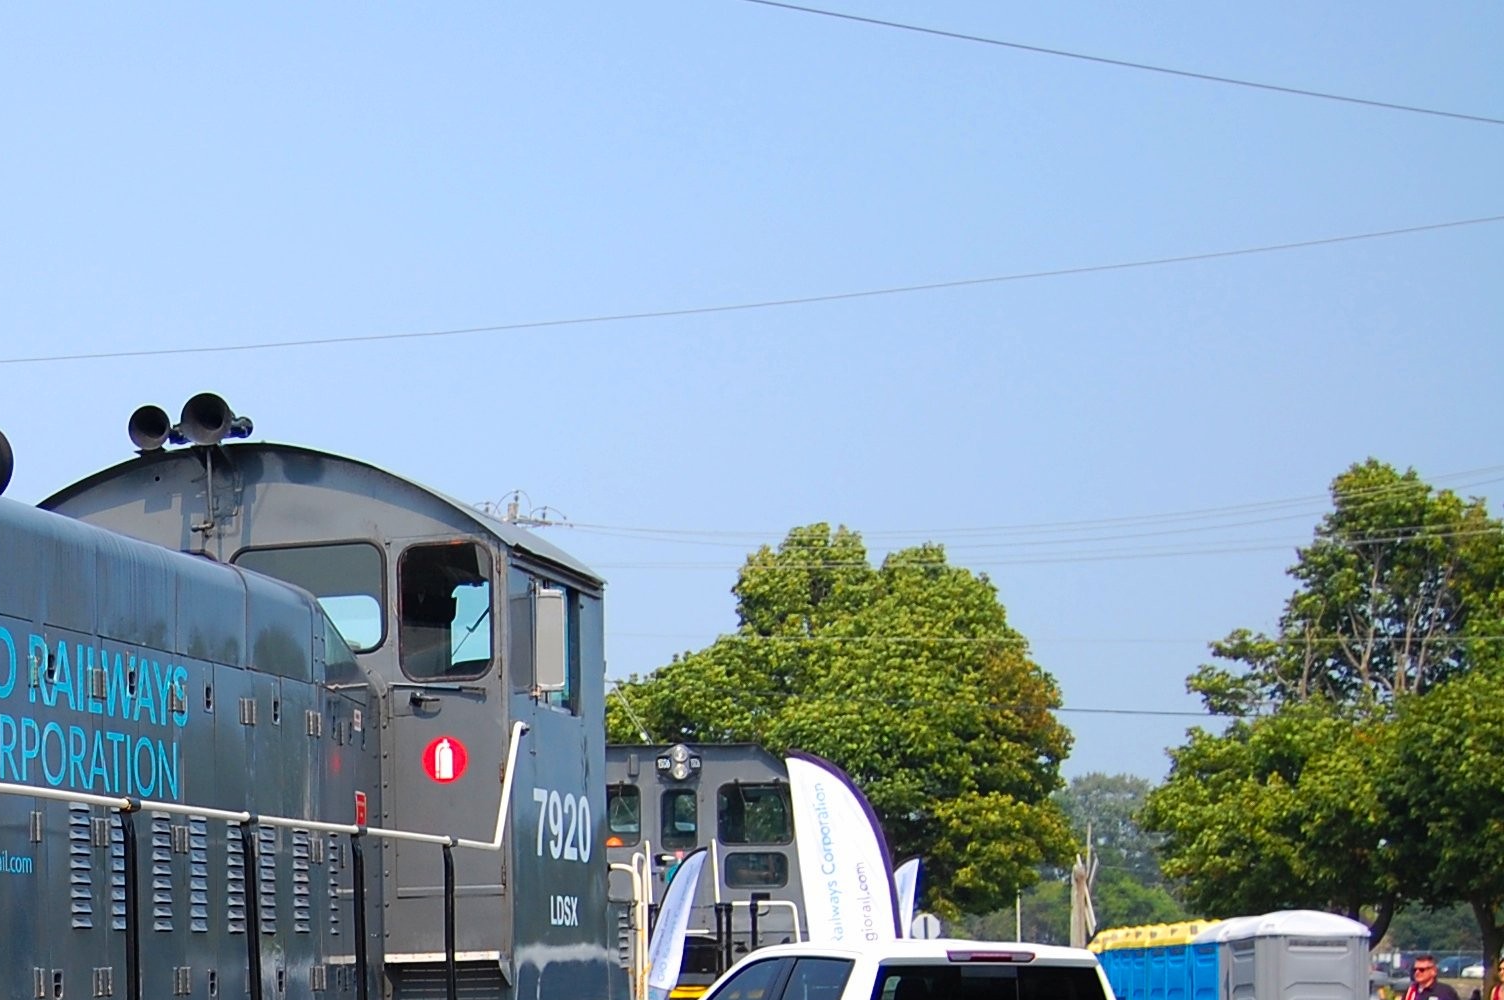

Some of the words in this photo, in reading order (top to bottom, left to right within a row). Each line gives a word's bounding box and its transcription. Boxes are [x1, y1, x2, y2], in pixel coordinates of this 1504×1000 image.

[28, 633, 189, 728] RAILWAYS
[533, 787, 592, 863] 7920
[813, 782, 836, 876] Corporation
[550, 895, 579, 927] LDSX
[856, 861, 878, 942] giorail.com
